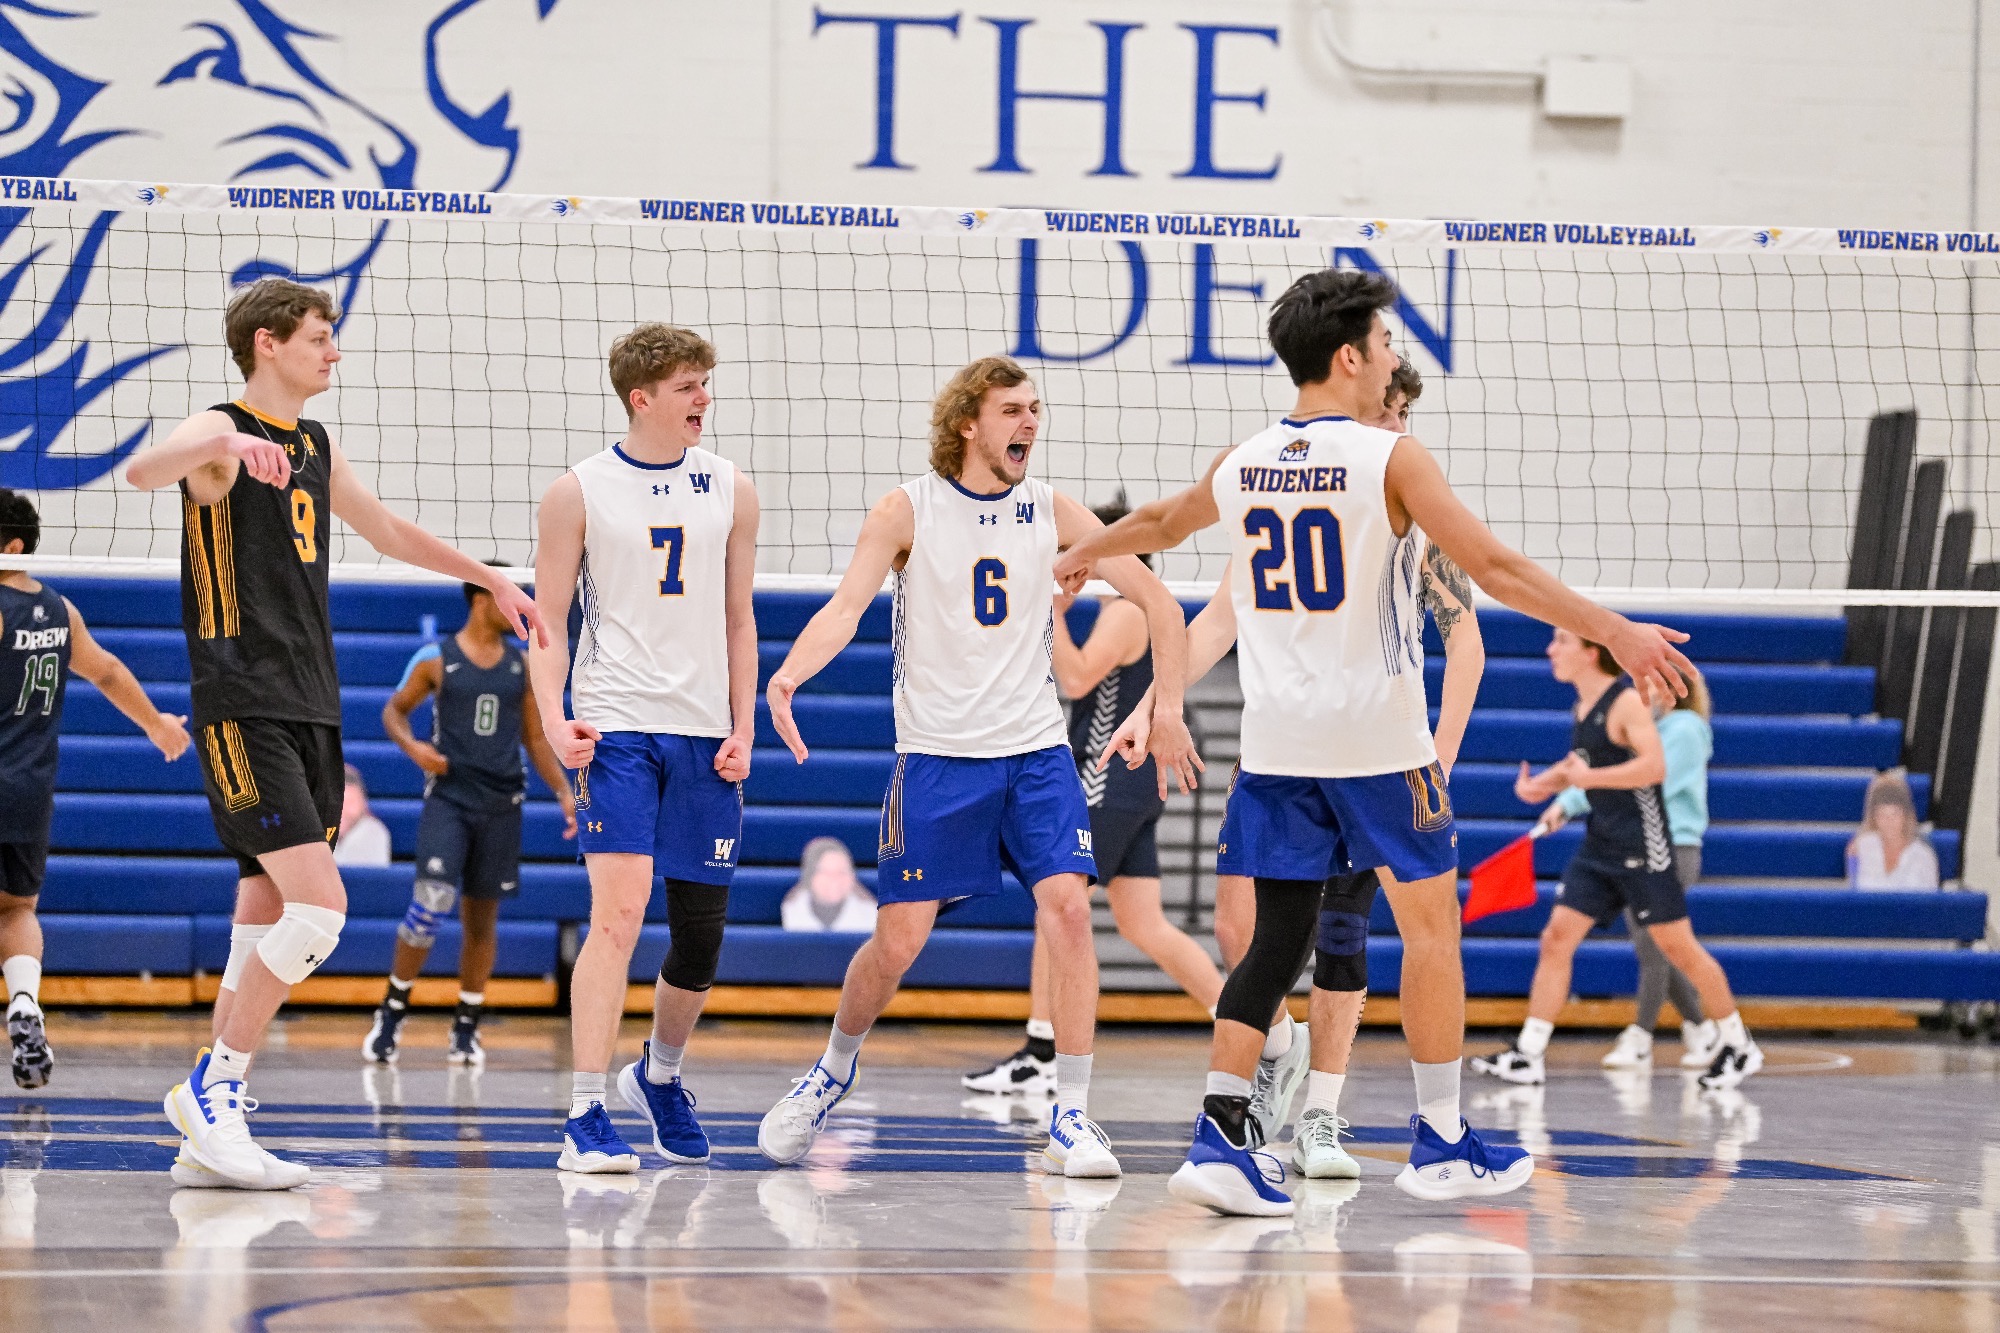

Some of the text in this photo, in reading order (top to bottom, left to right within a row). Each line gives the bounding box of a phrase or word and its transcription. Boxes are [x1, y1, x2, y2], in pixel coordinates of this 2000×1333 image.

[812, 9, 1282, 180] THE
[1, 179, 77, 201] YBALL
[227, 187, 492, 214] WIDENER VOLLEYBALL
[640, 199, 899, 228] WIDENER VOLLEYBALL
[1045, 211, 1300, 238] WIDENER VOLLEYBALL
[1445, 222, 1696, 246] WIDENER VOLLEYBALL
[1838, 229, 2000, 253] WIDENER VOLL
[1279, 448, 1308, 461] MAC
[689, 473, 711, 493] W
[1240, 466, 1347, 493] WIDENER
[291, 488, 317, 563] 9
[648, 525, 685, 597] 7
[1243, 505, 1347, 614] 20
[972, 556, 1009, 628] 6
[12, 627, 69, 650] DREW
[14, 652, 59, 716] 19
[474, 693, 499, 736] 8
[715, 838, 735, 860] W
